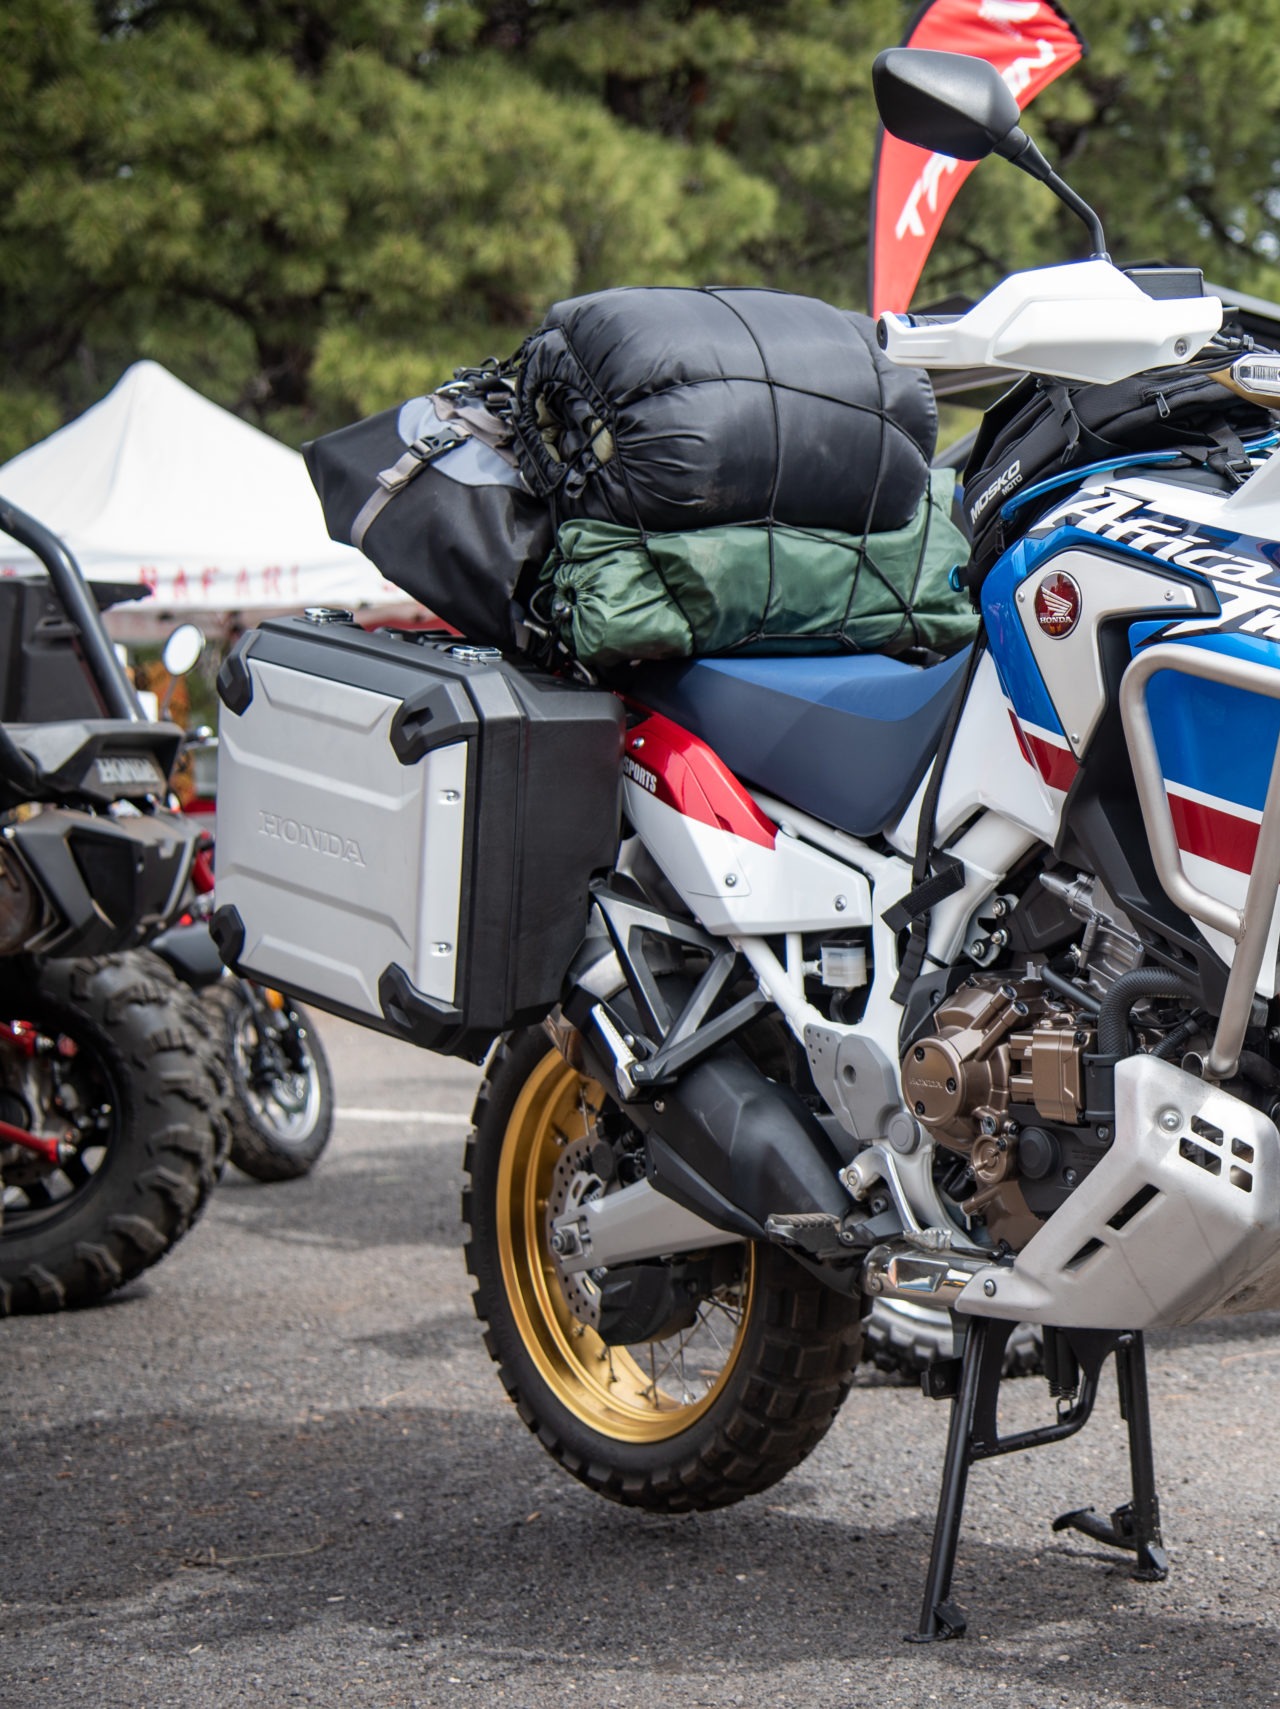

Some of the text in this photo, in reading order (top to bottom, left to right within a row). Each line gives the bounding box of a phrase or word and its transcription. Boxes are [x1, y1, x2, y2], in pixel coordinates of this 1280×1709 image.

[895, 39, 1056, 240] TAN
[970, 459, 1020, 525] MOSKO
[1001, 473, 1023, 495] MOTO
[1039, 616, 1073, 624] HONDA
[623, 755, 657, 793] SPORTS
[258, 809, 367, 868] HONDA
